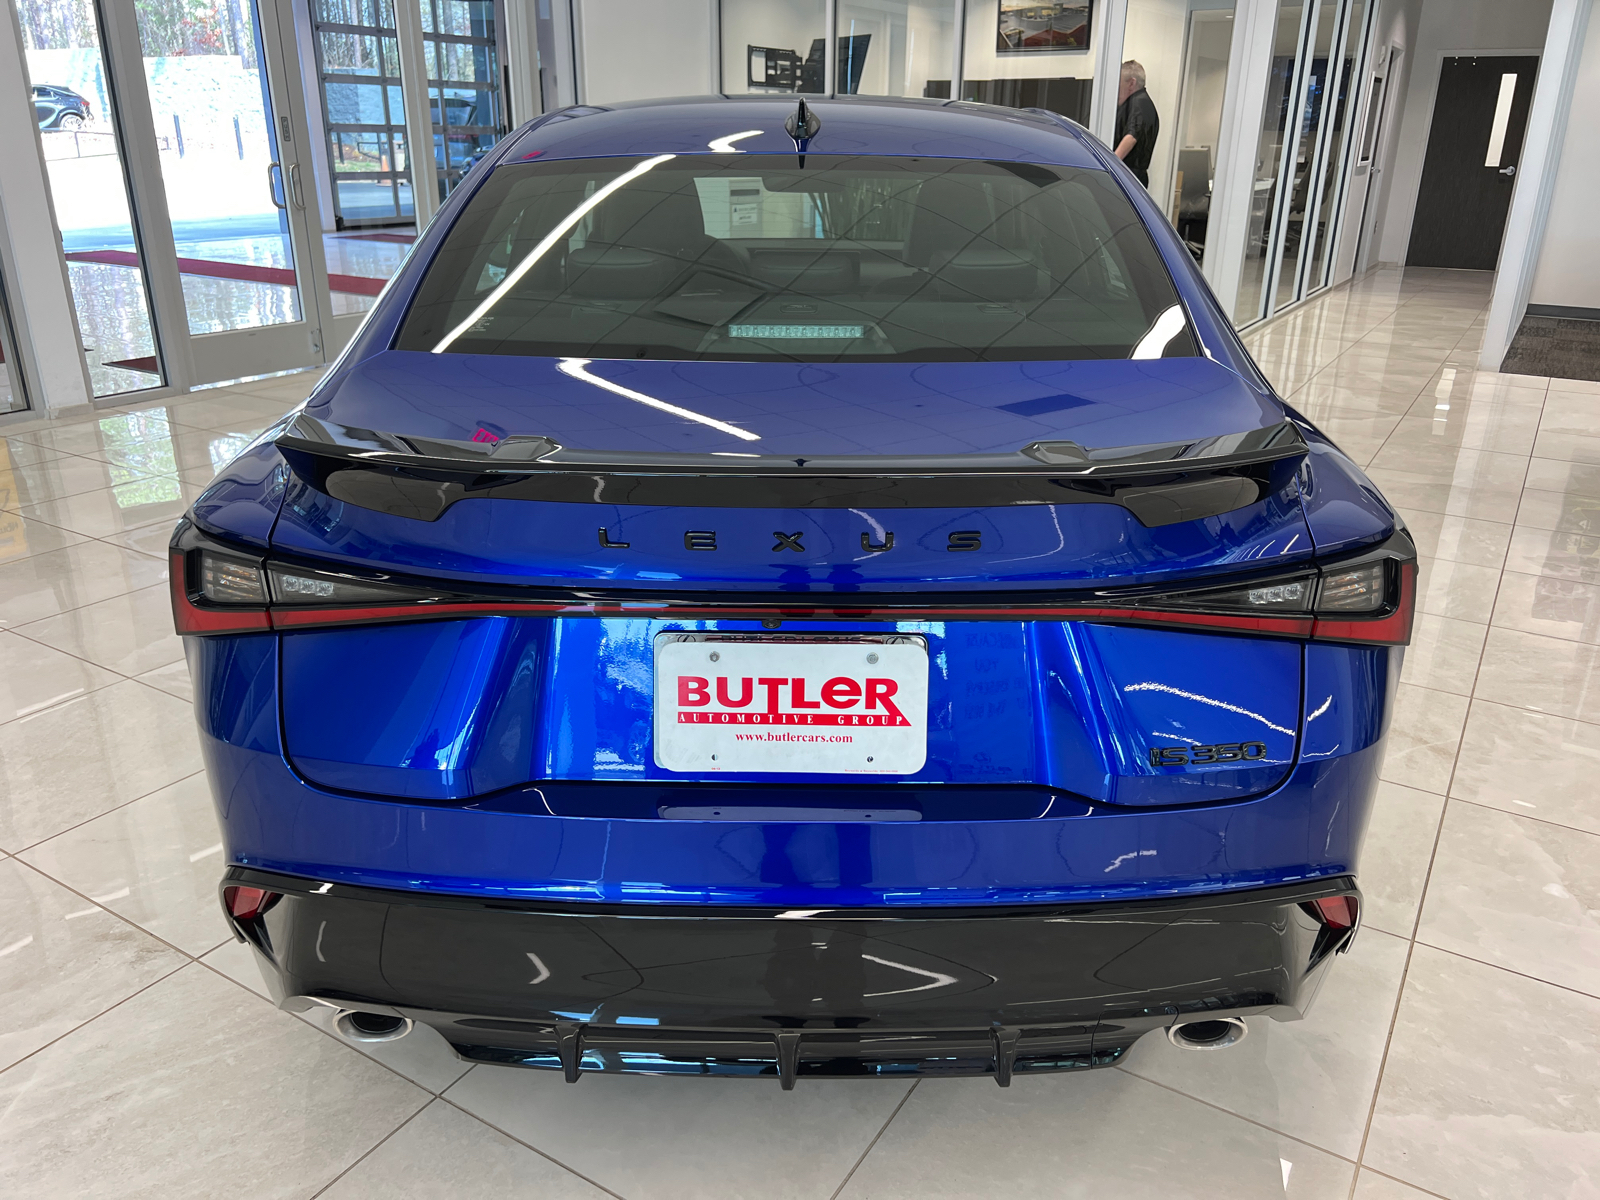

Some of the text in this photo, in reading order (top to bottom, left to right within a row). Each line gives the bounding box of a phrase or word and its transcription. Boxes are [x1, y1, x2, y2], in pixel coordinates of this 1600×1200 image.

[598, 526, 982, 553] LEXUS
[678, 713, 904, 725] AUTOMOTIVE GROUP
[735, 731, 854, 743] www.butlercars.com
[1150, 741, 1267, 767] IS 350
